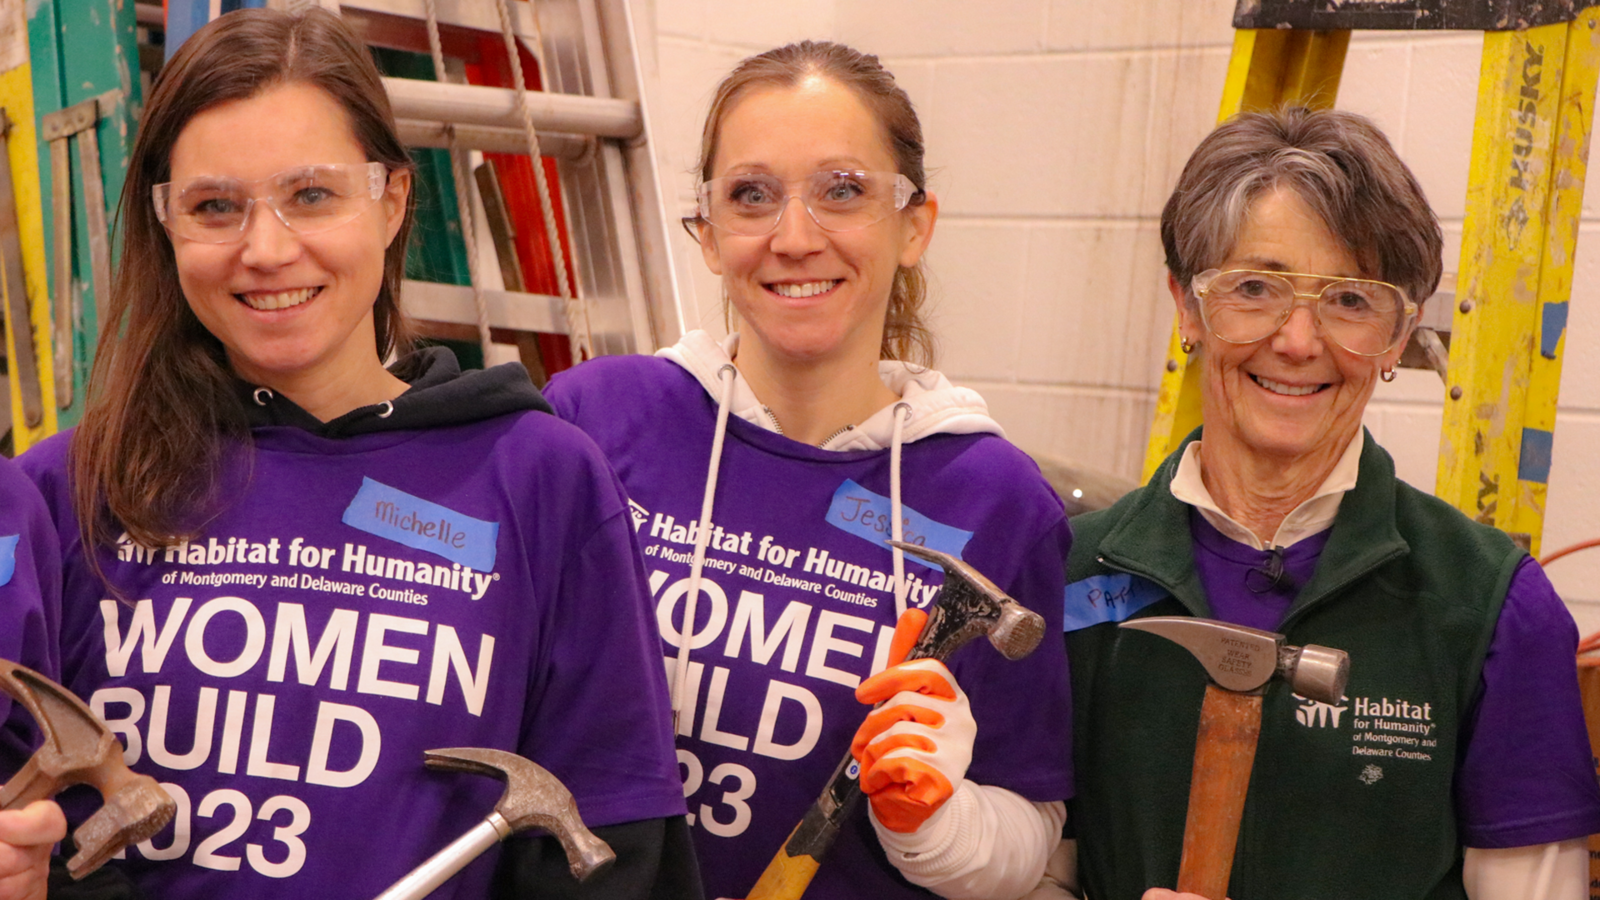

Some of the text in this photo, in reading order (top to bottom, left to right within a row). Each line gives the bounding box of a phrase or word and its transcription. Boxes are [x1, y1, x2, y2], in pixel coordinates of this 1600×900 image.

[375, 500, 466, 549] Michelle
[165, 537, 281, 565] Habitat
[288, 537, 336, 568] for
[757, 535, 801, 568] for
[162, 571, 428, 605] of Montgomery and Delaware Counties
[645, 545, 878, 608] of Montmery and Delaware Counties
[99, 597, 495, 717] WOMEN
[1221, 637, 1260, 652] PATENTED
[1227, 649, 1250, 660] WEAR
[1222, 655, 1252, 669] SAFETY
[1354, 718, 1370, 729] for
[1355, 697, 1431, 720] Habitat
[89, 685, 381, 788] BUILD
[1353, 732, 1437, 748] of Montgomery and
[1352, 745, 1431, 761] Delaware Counties
[112, 782, 311, 878] 023
